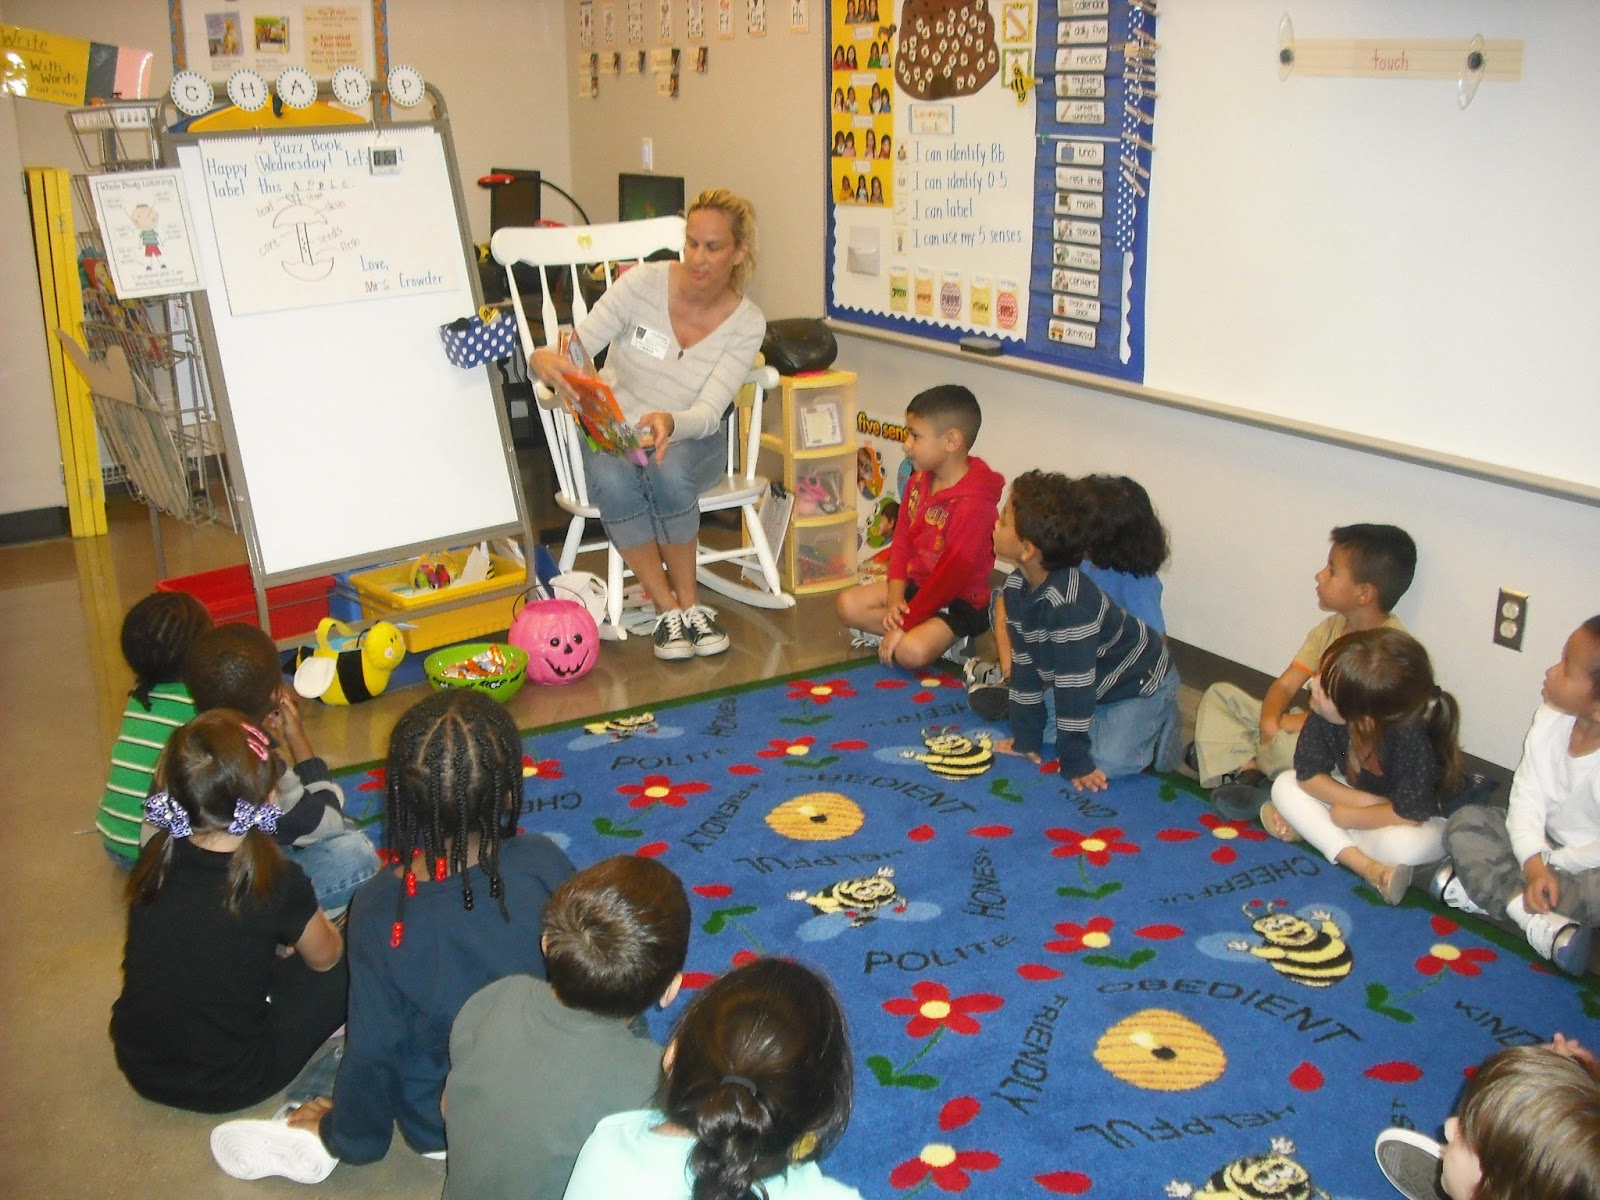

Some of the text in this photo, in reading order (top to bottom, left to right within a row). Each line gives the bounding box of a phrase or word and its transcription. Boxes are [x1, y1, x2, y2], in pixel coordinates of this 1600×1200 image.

[1, 29, 48, 50] Write
[1076, 55, 1102, 64] recess
[1371, 48, 1409, 72] touch
[40, 71, 78, 84] Words
[185, 78, 412, 101] C H A M P
[273, 138, 343, 156] Buzz Book
[925, 148, 942, 162] can
[946, 143, 986, 167] identify
[991, 142, 1005, 163] Bb
[1079, 147, 1097, 158] lunch
[206, 158, 248, 180] Happy
[259, 151, 333, 174] Wednesday!
[211, 179, 245, 198] label
[258, 177, 282, 194] this
[924, 177, 942, 191] can
[947, 171, 983, 195] identify
[924, 206, 943, 220] can
[946, 197, 974, 218] label
[1076, 200, 1097, 210] math
[258, 239, 281, 257] core
[923, 234, 940, 246] can
[942, 231, 958, 244] use
[961, 232, 976, 248] my
[990, 230, 1022, 244] senses
[360, 255, 389, 272] Love,
[400, 271, 444, 288] Crowder
[1070, 277, 1097, 289] centers
[857, 411, 880, 436] five
[611, 745, 737, 771] POLITE
[784, 773, 977, 814] OBEDIENT
[680, 783, 760, 852] FRIENDLY
[962, 846, 1007, 921] HONEST
[864, 933, 1017, 975] POLITE
[1096, 978, 1363, 1044] OBEDIENT
[1454, 999, 1546, 1048] KIND
[990, 992, 1070, 1116] FRIENDLY
[1074, 1104, 1297, 1150] HELPFUL
